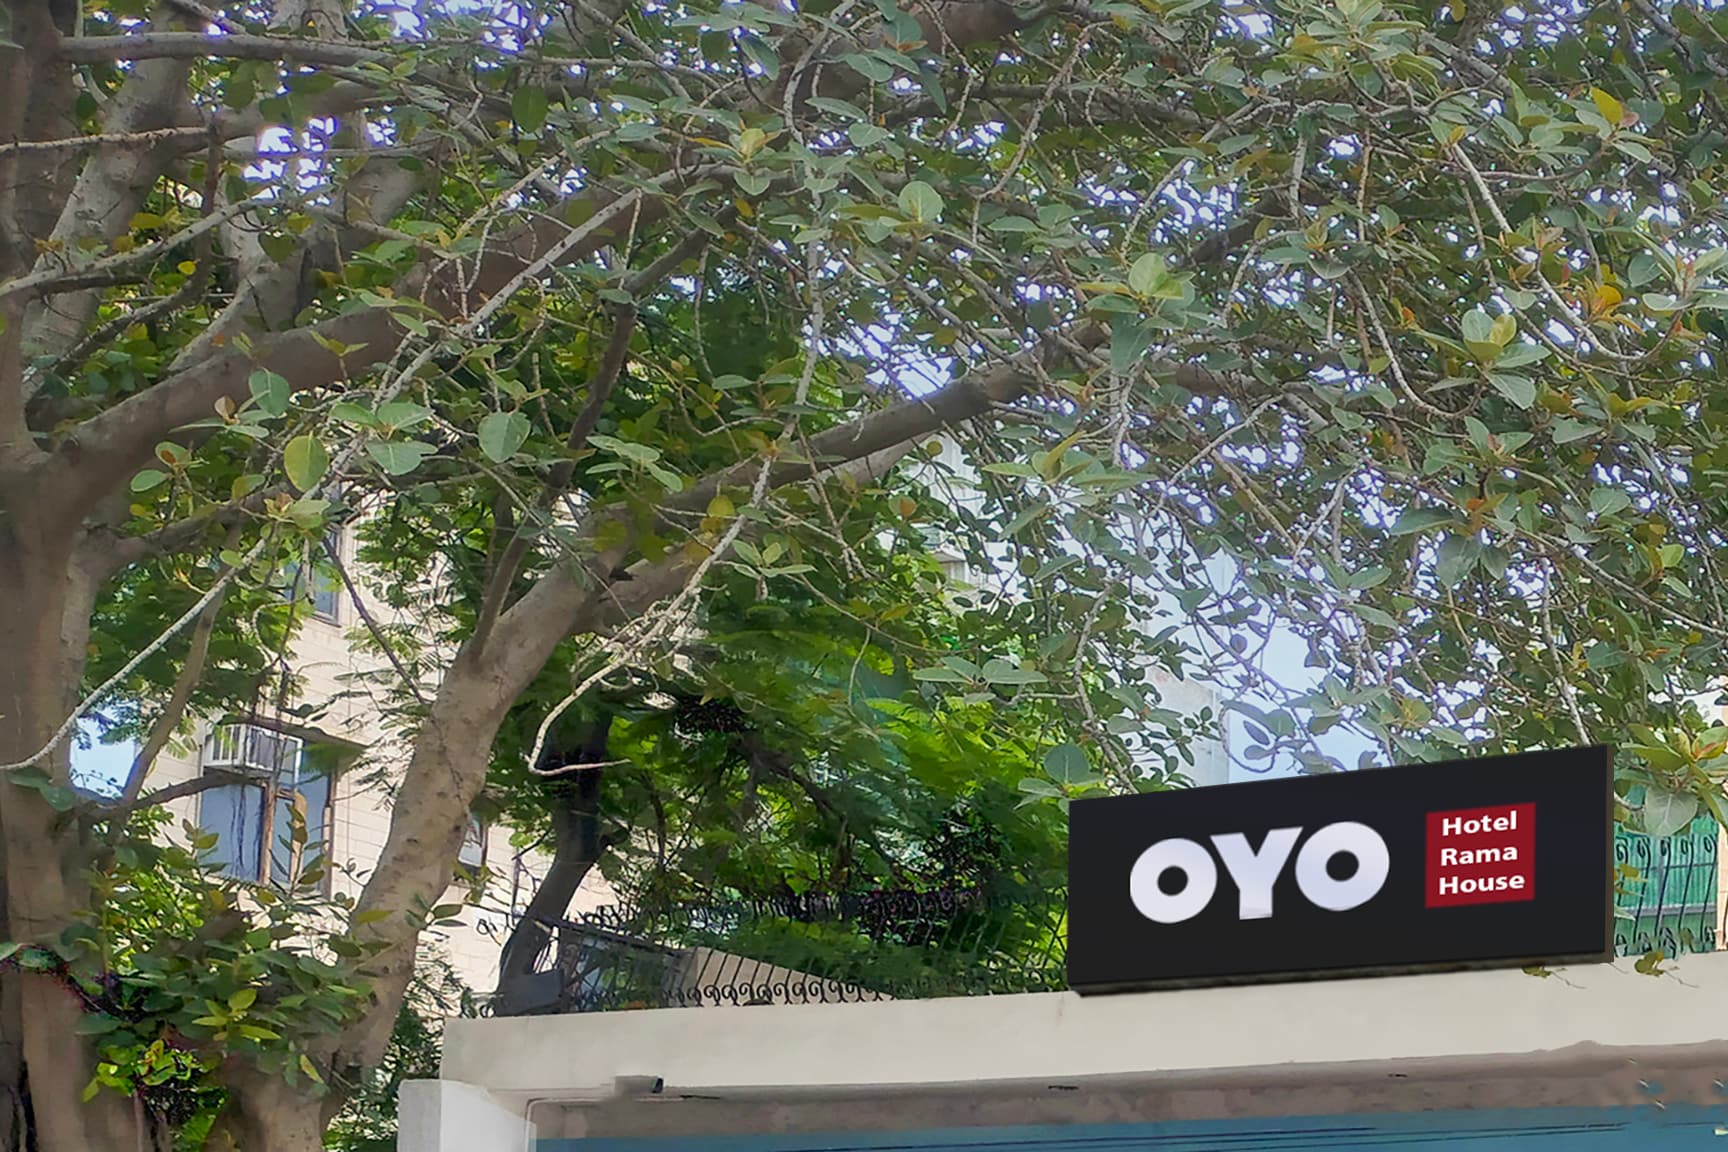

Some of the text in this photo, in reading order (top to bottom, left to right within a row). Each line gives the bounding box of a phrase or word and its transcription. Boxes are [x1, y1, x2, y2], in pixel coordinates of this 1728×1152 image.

[1442, 810, 1517, 836] Hotel
[1440, 846, 1518, 867] Rama
[1129, 821, 1390, 924] OYO
[1439, 875, 1526, 896] House
